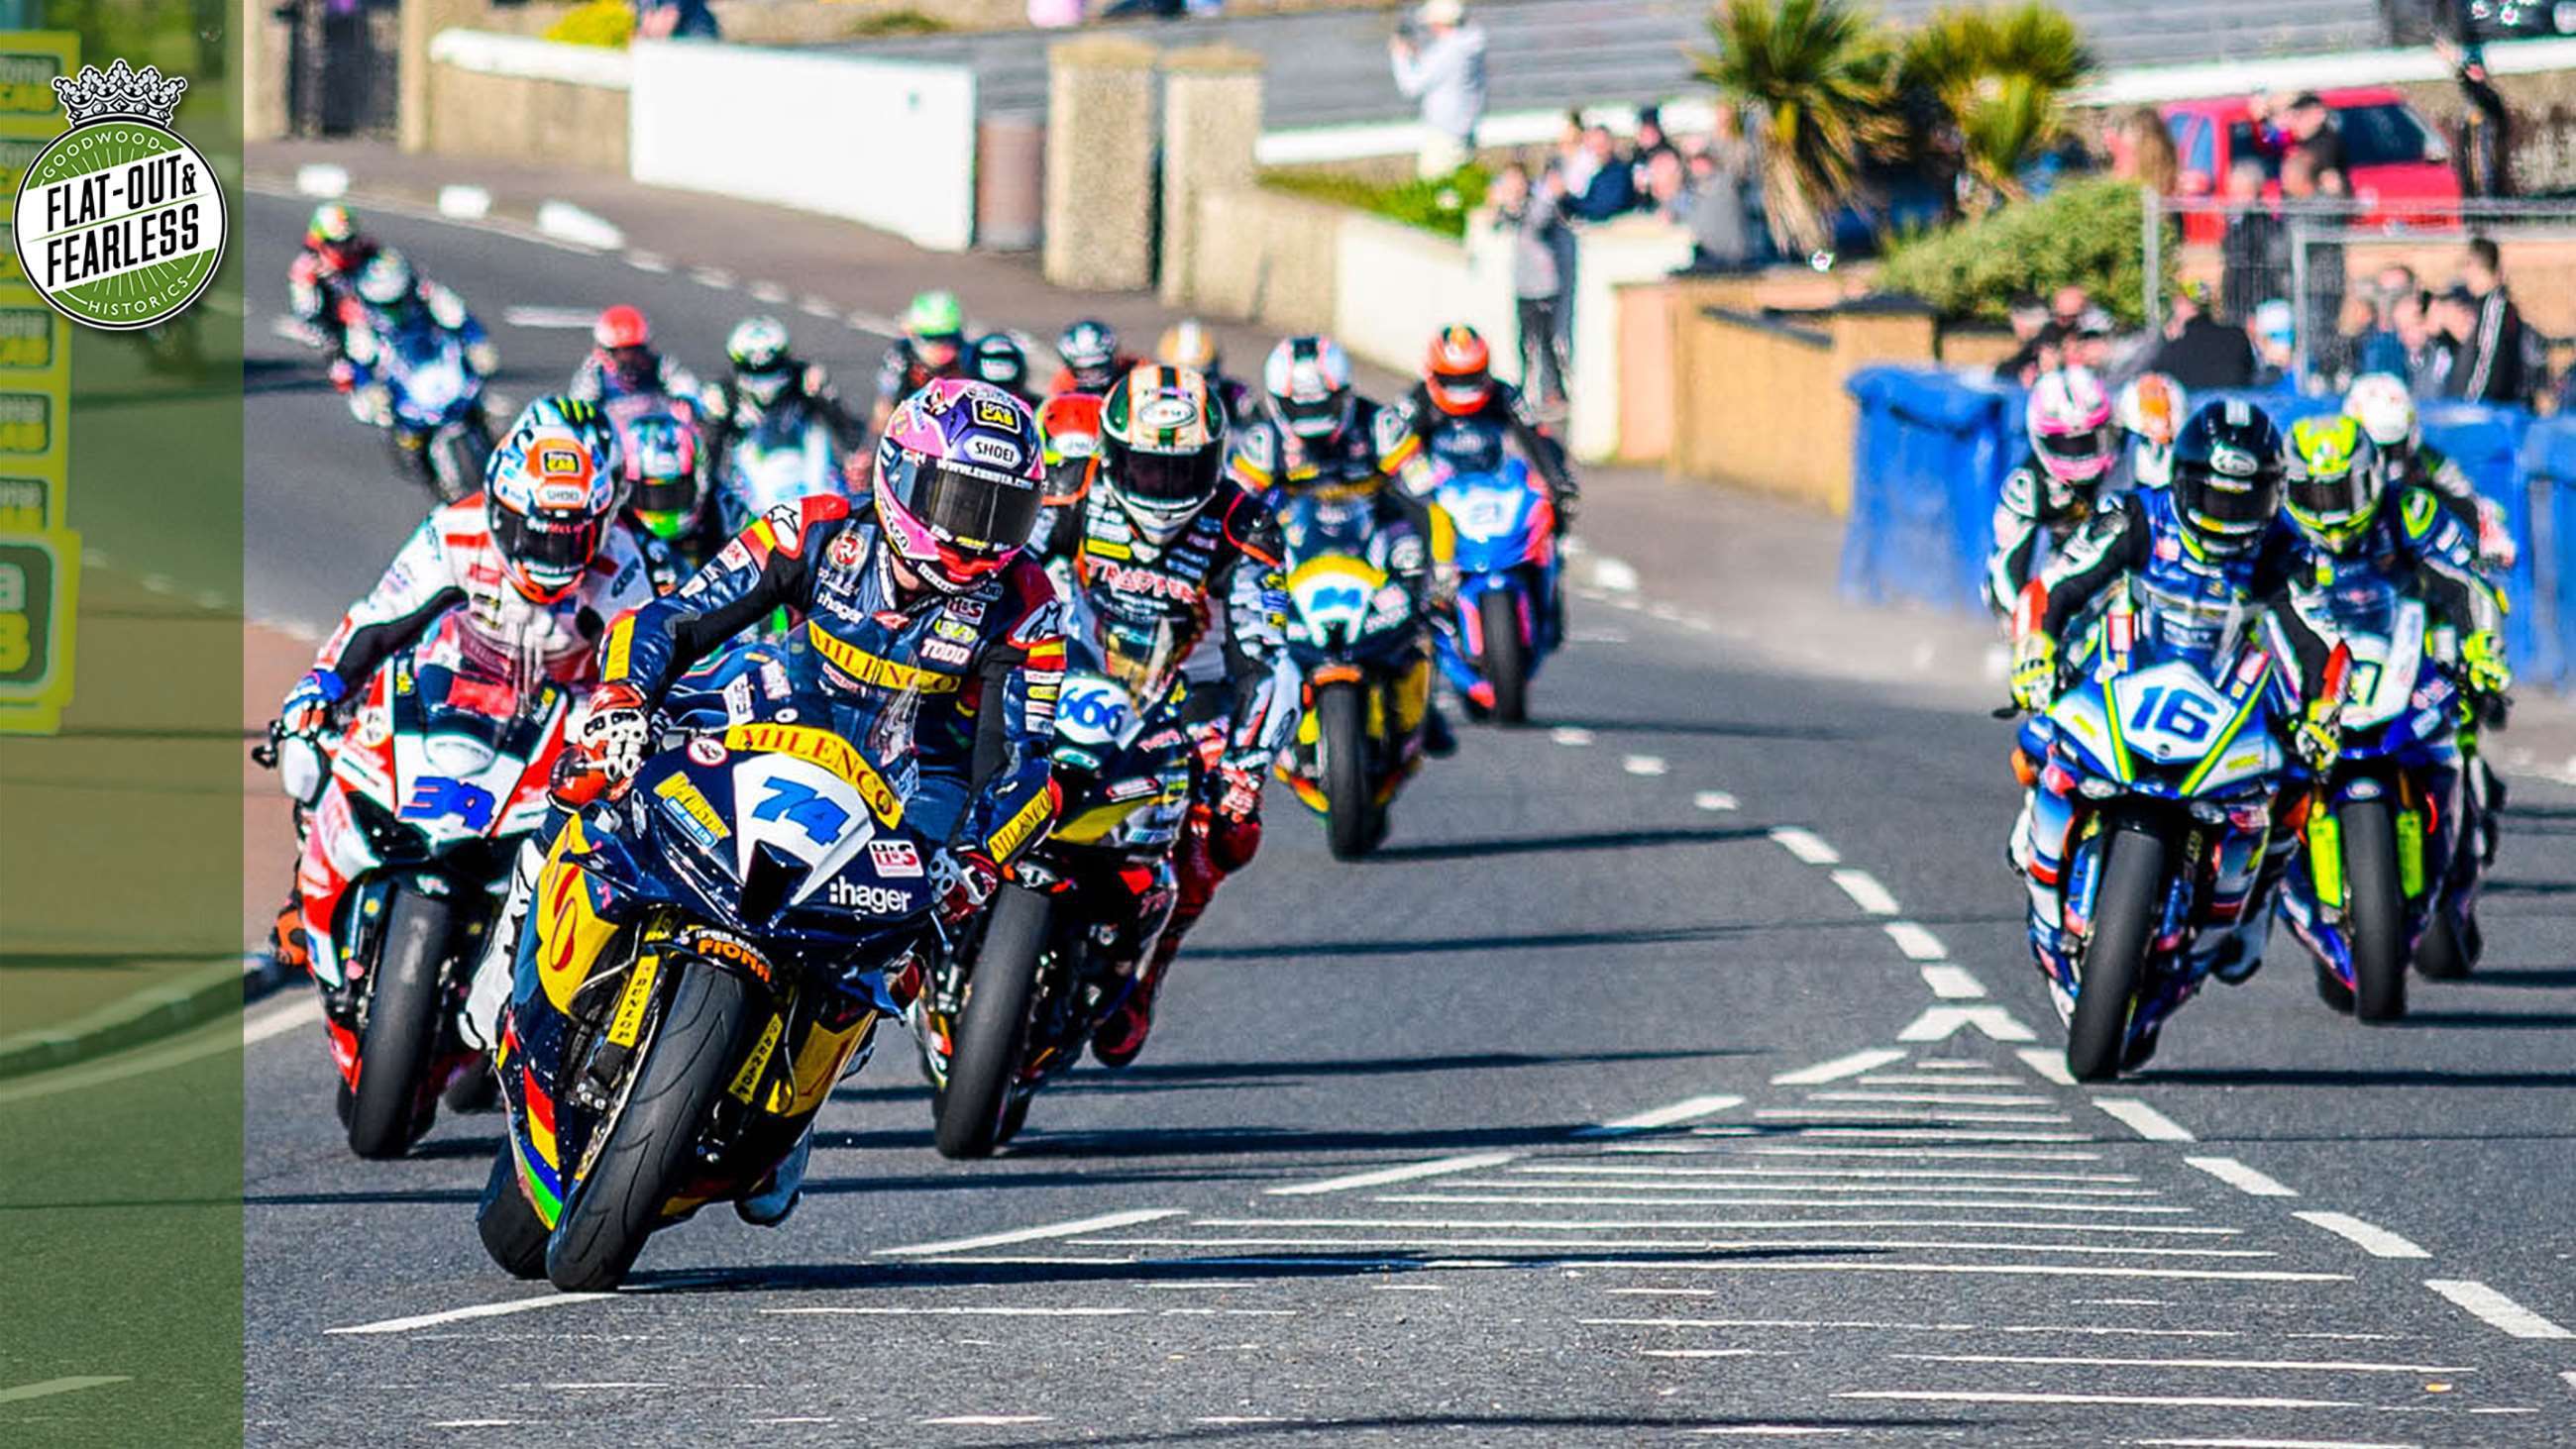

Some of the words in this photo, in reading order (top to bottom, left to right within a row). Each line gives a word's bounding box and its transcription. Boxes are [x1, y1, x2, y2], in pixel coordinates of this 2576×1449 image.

[975, 441, 1015, 463] SHOEI
[920, 638, 972, 666] TODD
[1056, 685, 1127, 737] 666
[2131, 685, 2218, 743] 16
[741, 728, 894, 816] MILENCO
[751, 776, 851, 846] 74
[991, 792, 1052, 857] MILENCO
[698, 939, 771, 983] FIONA
